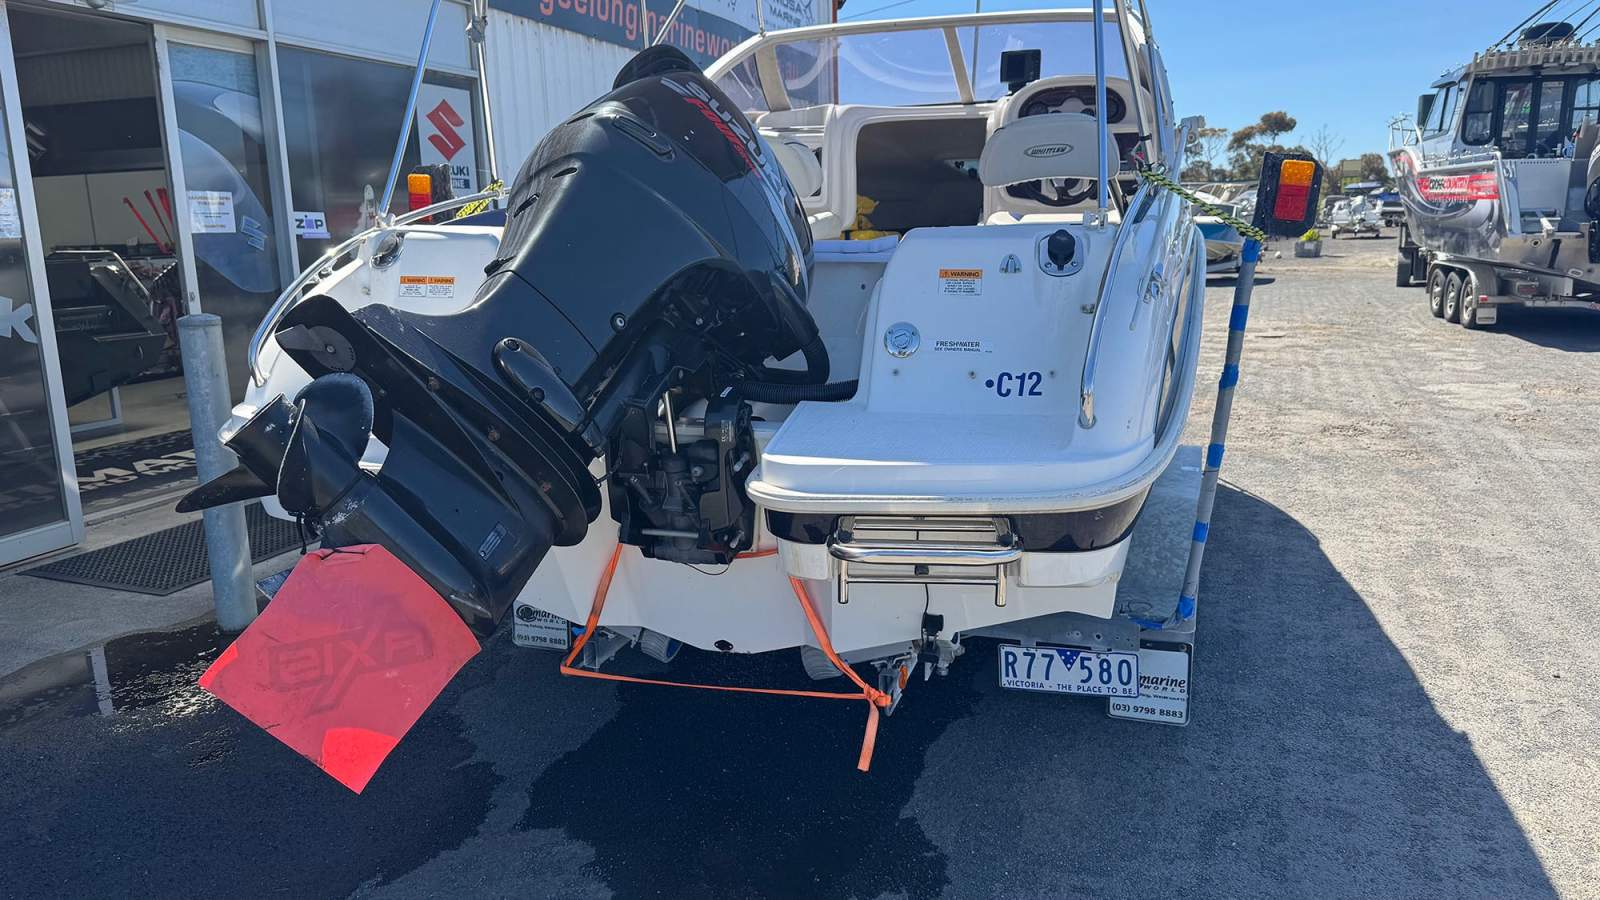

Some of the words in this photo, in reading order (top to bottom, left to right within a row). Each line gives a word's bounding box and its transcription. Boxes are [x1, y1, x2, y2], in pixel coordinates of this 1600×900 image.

[1004, 650, 1055, 681] R77
[1079, 657, 1133, 686] 580
[1006, 681, 1045, 689] VICTORIA
[1057, 683, 1072, 691] THE
[1077, 685, 1102, 693] PLACE
[1106, 686, 1118, 694] TO
[1139, 675, 1186, 688] marine
[1112, 703, 1131, 713] (03)
[1133, 705, 1156, 716] 9798
[1159, 707, 1184, 719] 8883
